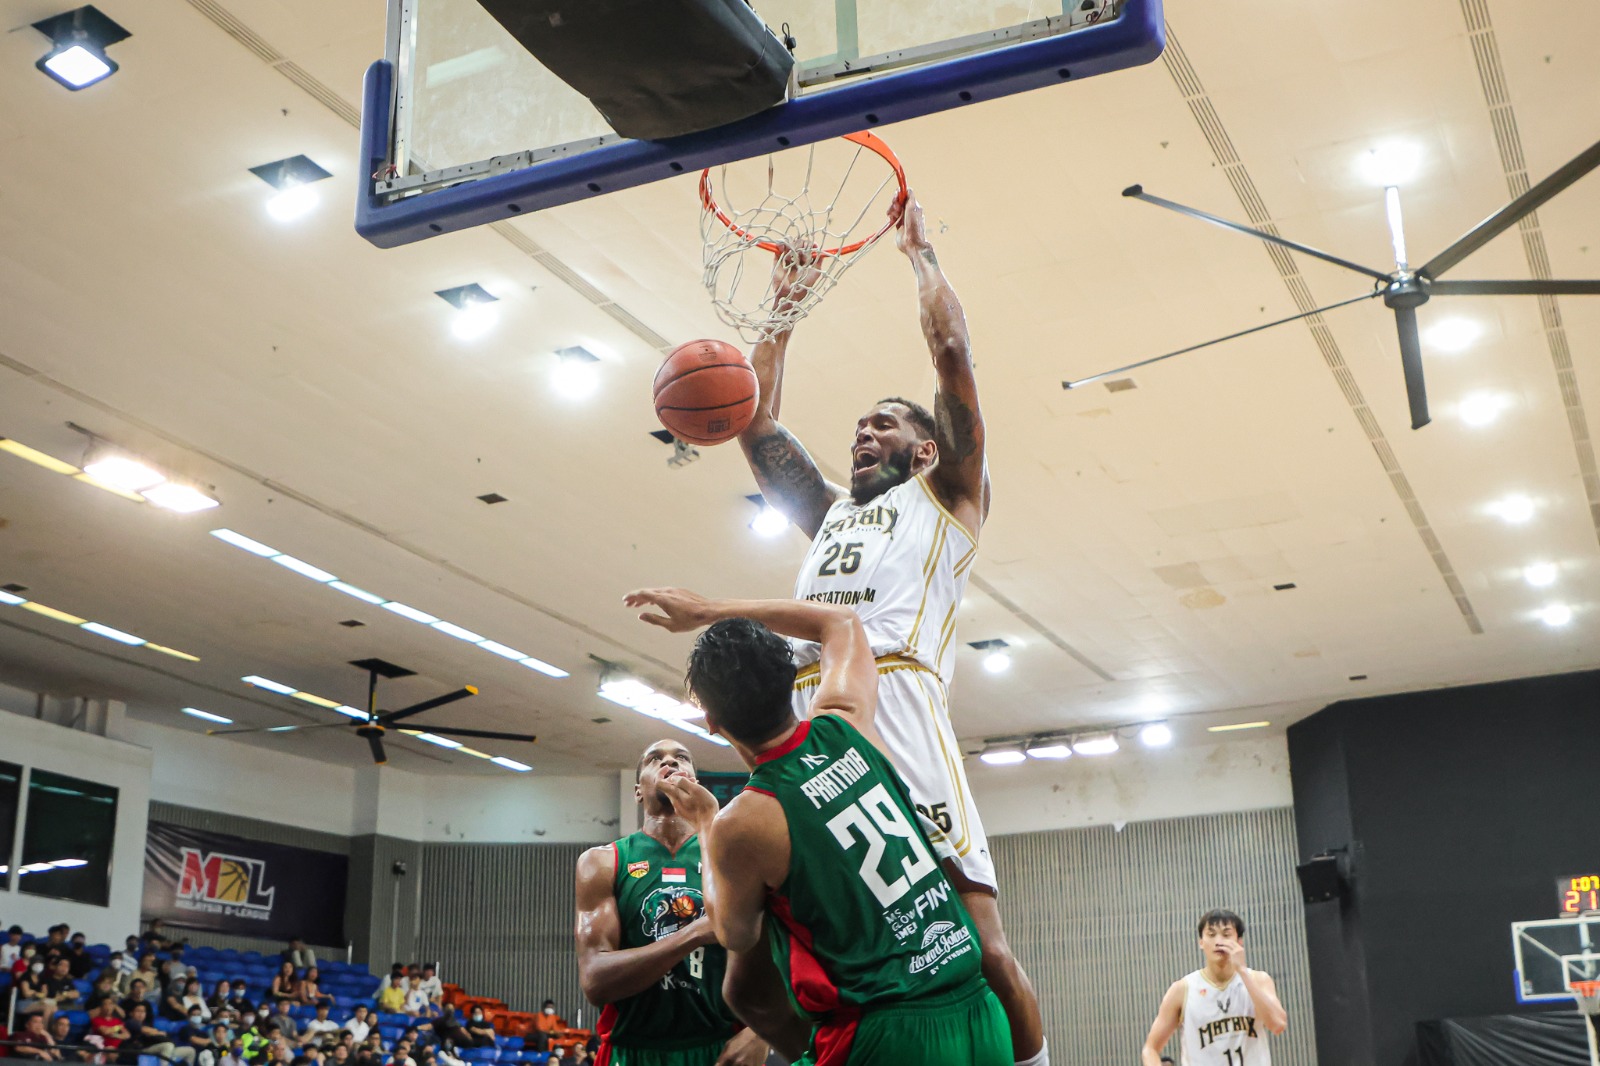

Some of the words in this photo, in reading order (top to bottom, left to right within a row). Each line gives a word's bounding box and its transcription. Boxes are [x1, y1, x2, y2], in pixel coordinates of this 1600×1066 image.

[818, 541, 864, 577] 25
[800, 747, 871, 810] PRATAMA
[825, 782, 938, 909] 29
[1198, 1015, 1258, 1050] MATRIX
[1223, 1046, 1244, 1066] 11
